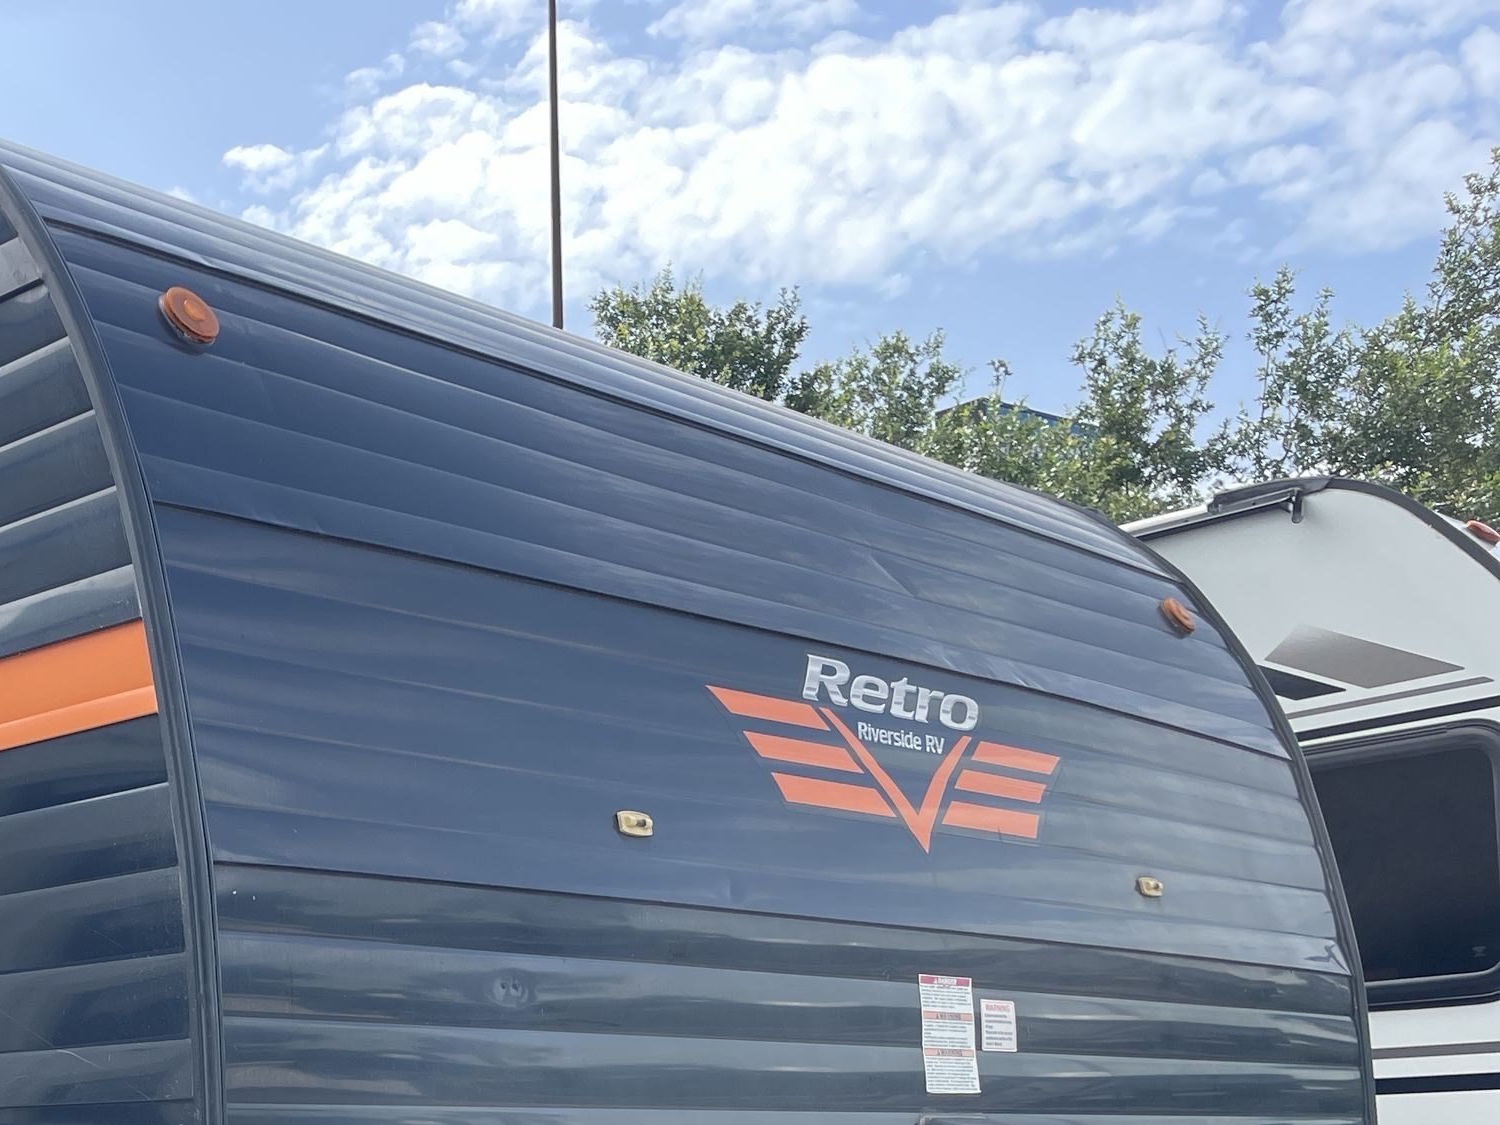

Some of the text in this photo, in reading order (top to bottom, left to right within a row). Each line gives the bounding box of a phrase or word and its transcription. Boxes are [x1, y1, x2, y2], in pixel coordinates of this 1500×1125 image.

[802, 653, 979, 732] Retro
[857, 721, 945, 755] Riverside RV
[985, 1003, 1012, 1013] WARNING
